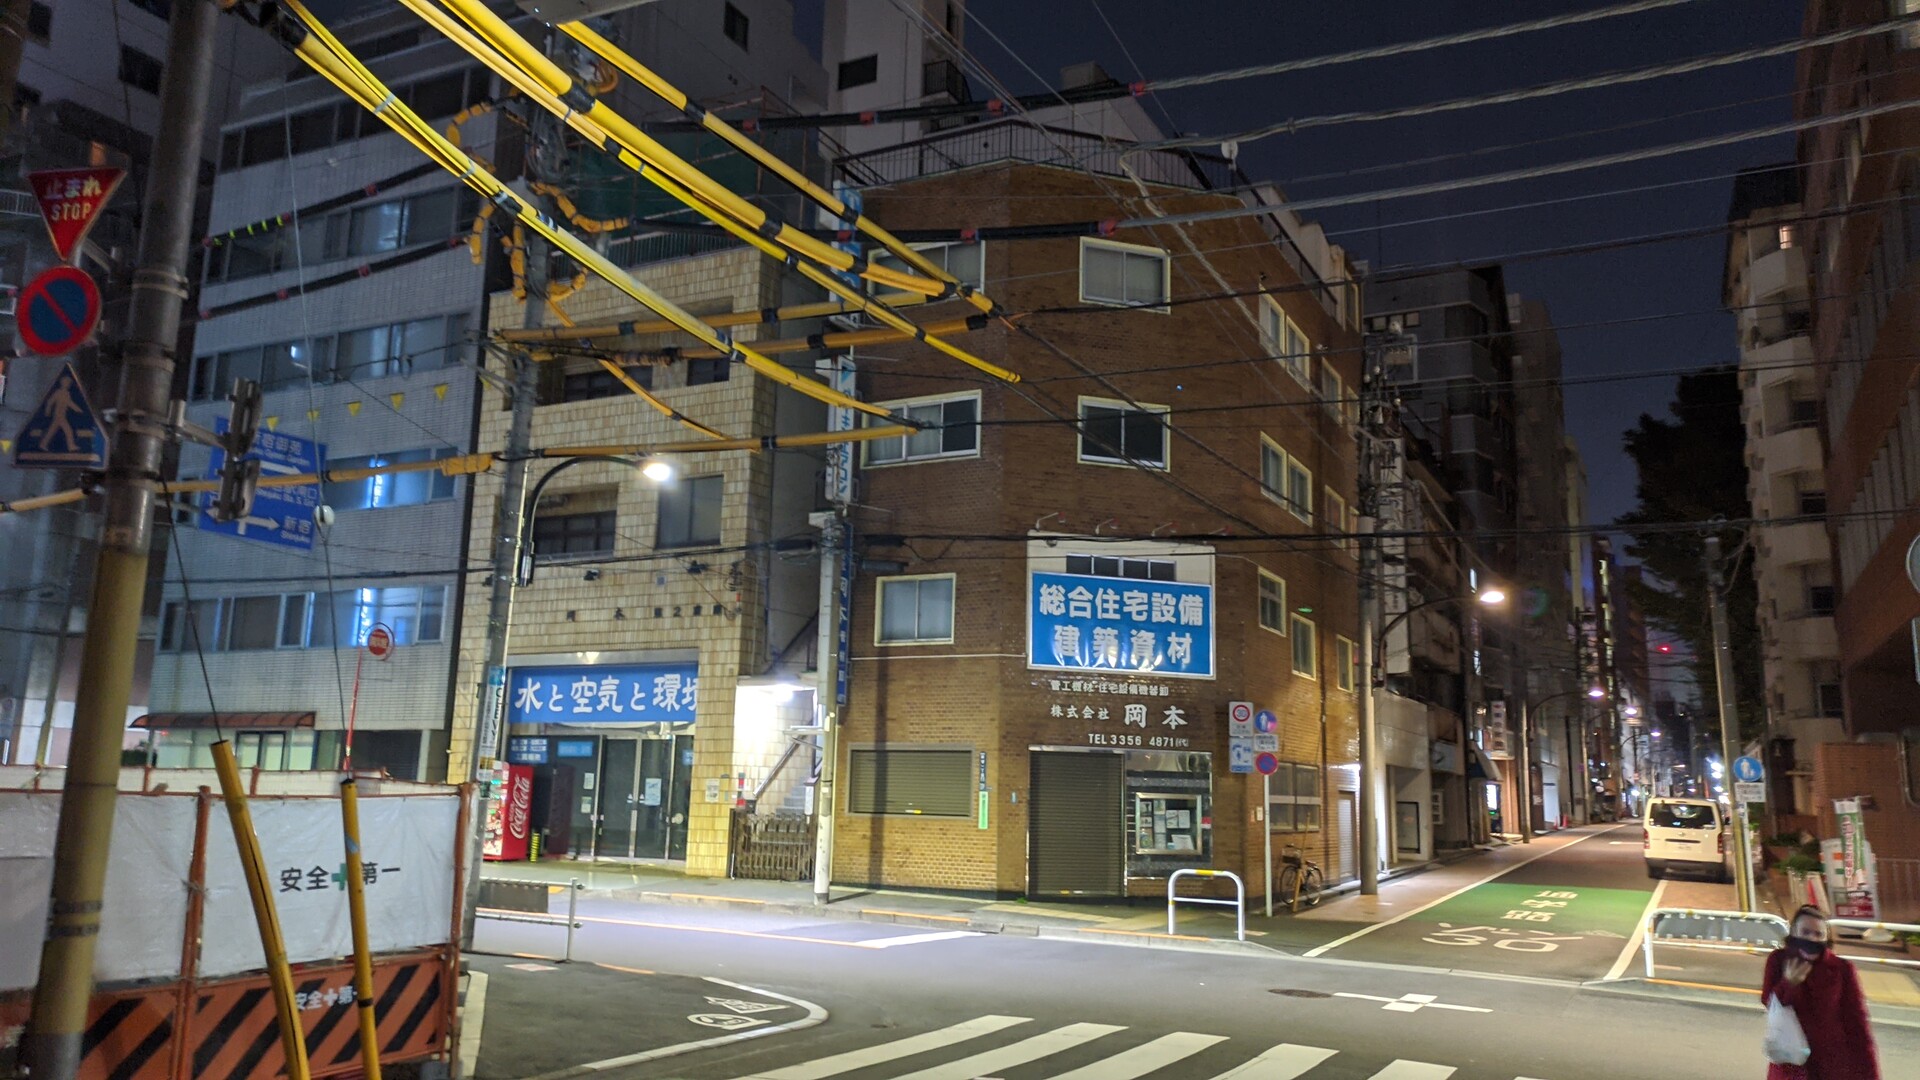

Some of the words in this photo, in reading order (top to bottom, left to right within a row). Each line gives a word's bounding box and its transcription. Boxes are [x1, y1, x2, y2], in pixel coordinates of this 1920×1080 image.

[44, 175, 102, 200] 止まれ
[51, 202, 92, 222] STOP
[1039, 583, 1204, 627] 総合住宅設備
[1053, 625, 1193, 664] 建築資材
[1050, 704, 1110, 720] 株式会社
[1124, 703, 1188, 730] 岡本
[1088, 733, 1107, 745] TEL
[1110, 734, 1142, 746] 3356
